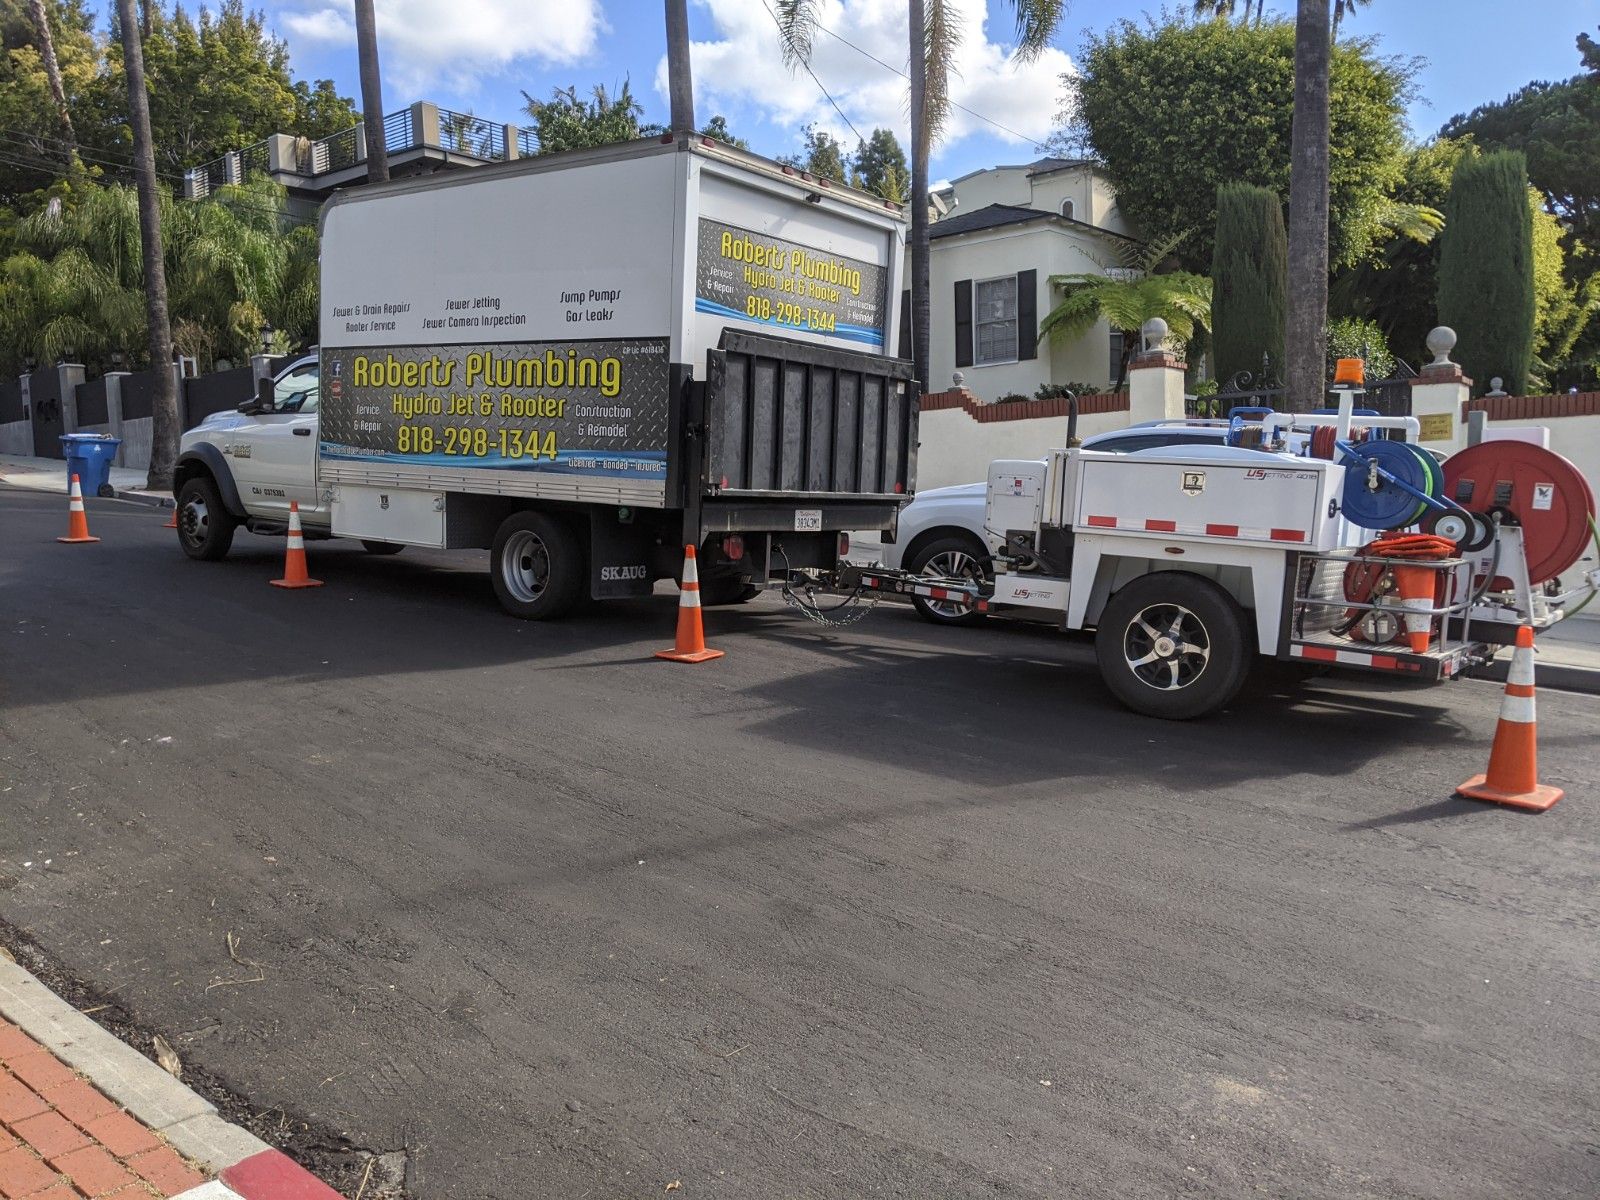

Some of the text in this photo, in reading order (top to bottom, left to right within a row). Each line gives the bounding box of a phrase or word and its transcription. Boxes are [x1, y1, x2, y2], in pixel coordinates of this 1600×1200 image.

[721, 232, 861, 295] Roberts Plumbing
[710, 265, 733, 279] Service
[707, 279, 735, 294] & Repair
[744, 265, 841, 303] Hydro Jet & Rooter
[445, 295, 501, 311] Sewer Jetting
[560, 289, 622, 305] Sump Pumps
[333, 301, 411, 318] Sewer & Drain Repairs
[565, 308, 614, 322] Gas Leaks
[746, 295, 836, 332] 818-298-1344
[345, 320, 396, 333] Rooter Service
[422, 312, 526, 329] Sewer Camera Inspection
[353, 349, 622, 397] Roberts Plumbing
[355, 405, 380, 416] Service
[392, 393, 567, 419] Hydro Jet & Rooter
[575, 404, 632, 418] Construction
[353, 419, 382, 433] & Repair
[578, 423, 629, 437] & Remodel
[397, 425, 558, 460] 818-298-1344
[568, 457, 661, 472] Licensed Bonded Insured
[601, 565, 647, 581] SKAUG
